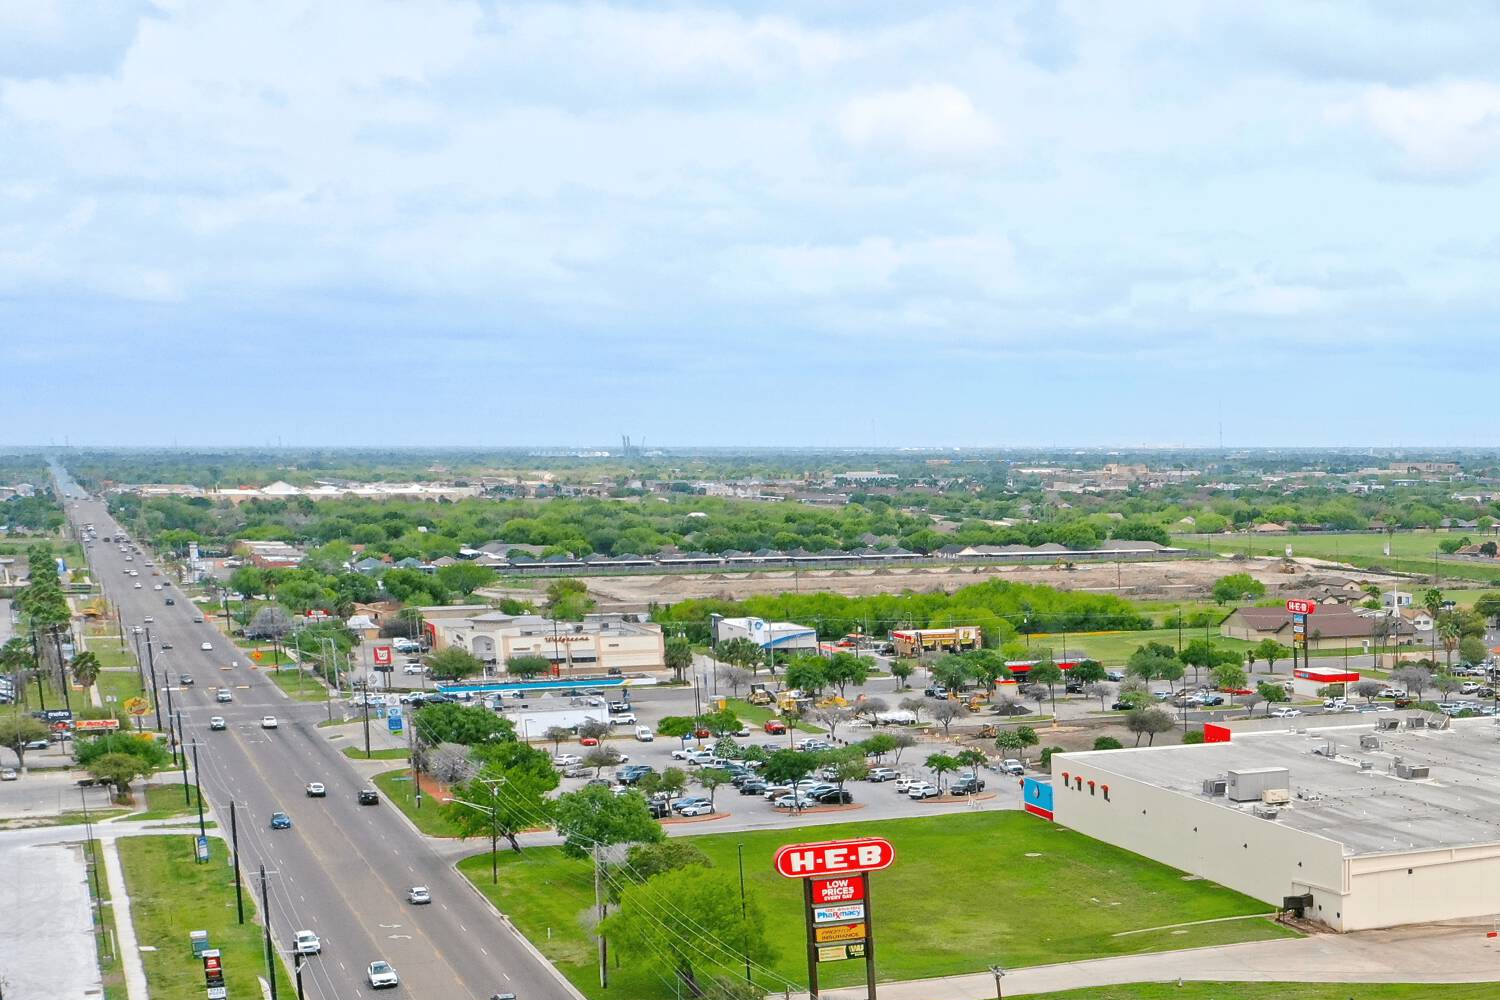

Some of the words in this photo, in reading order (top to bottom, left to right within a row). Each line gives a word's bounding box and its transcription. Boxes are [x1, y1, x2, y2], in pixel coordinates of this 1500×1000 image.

[1288, 602, 1307, 611] H-E-B
[790, 845, 882, 872] H-E-B
[826, 880, 848, 889] LOW
[821, 886, 855, 896] PRICES
